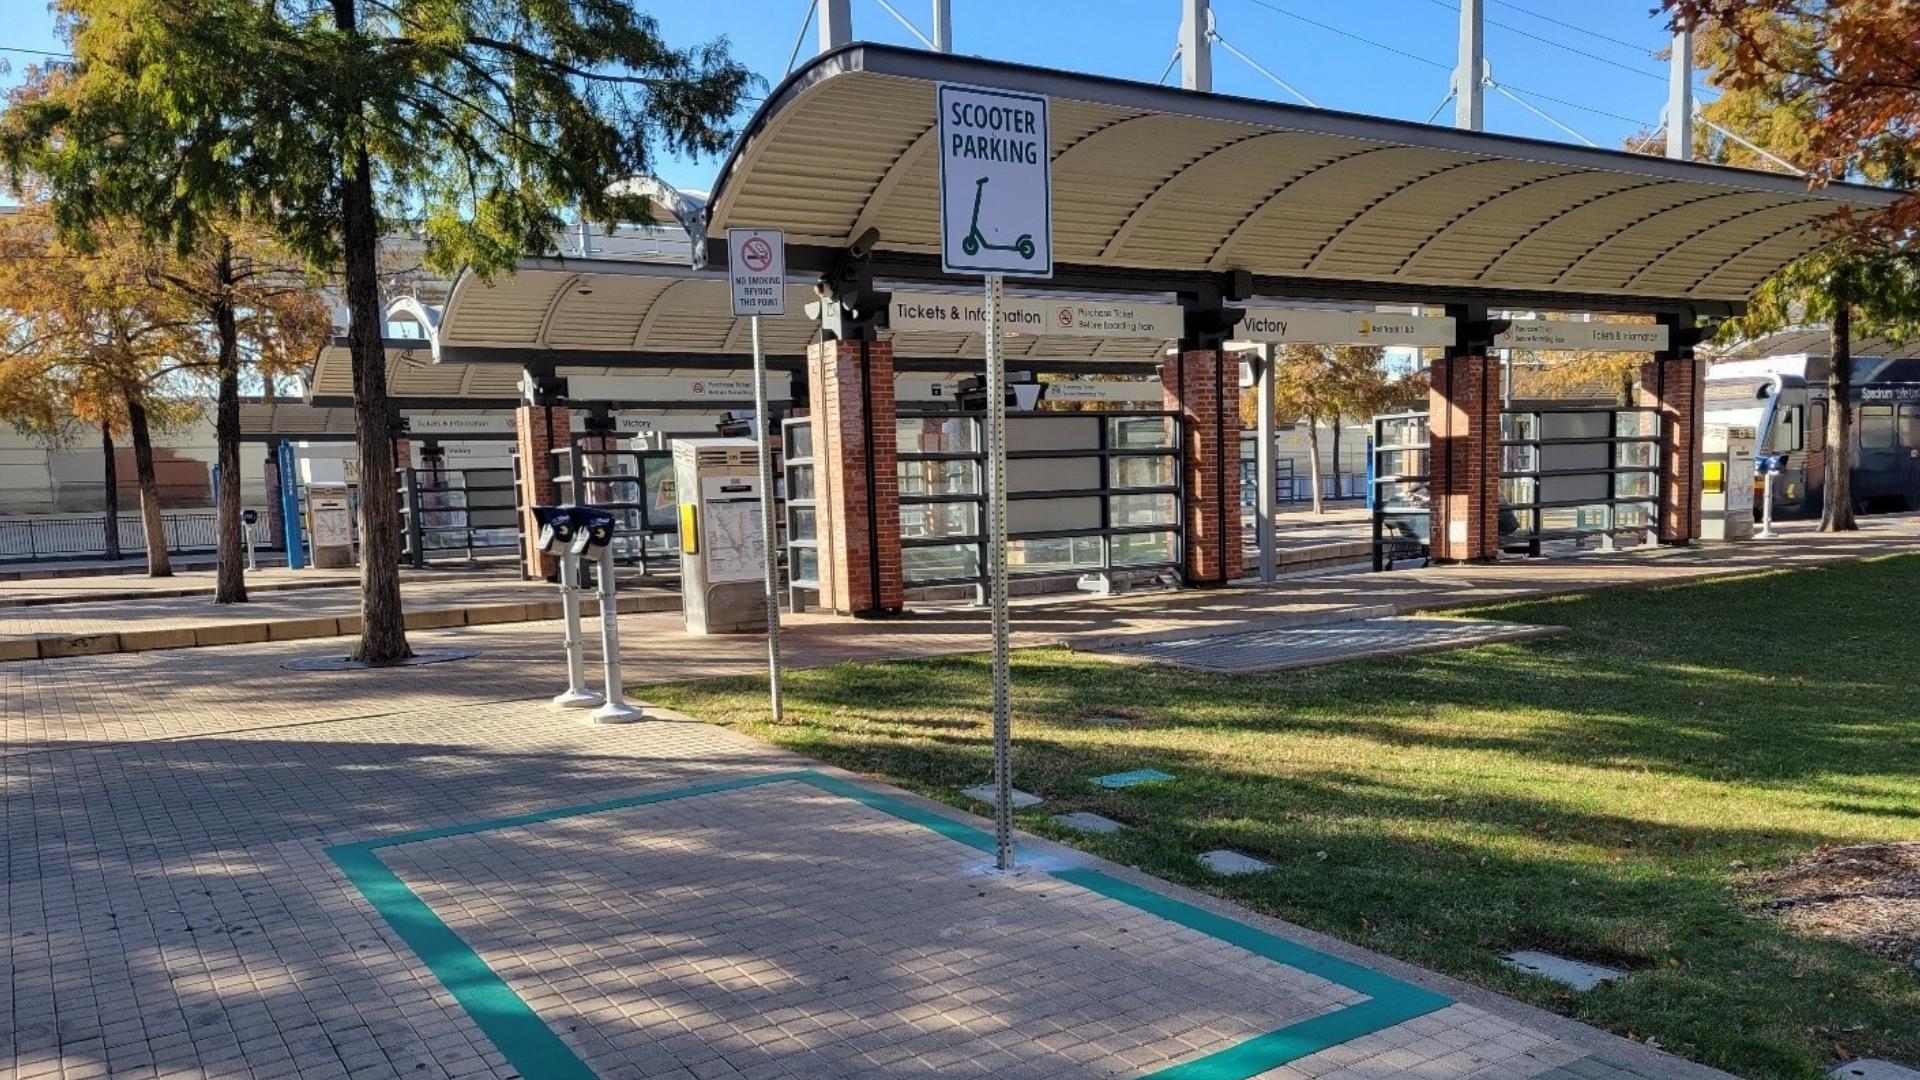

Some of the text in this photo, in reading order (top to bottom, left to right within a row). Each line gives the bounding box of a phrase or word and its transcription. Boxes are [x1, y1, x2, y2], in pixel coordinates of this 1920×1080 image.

[952, 102, 1036, 134] SCOOTER
[952, 133, 1037, 165] PARKING
[736, 276, 781, 285] NO SMOKING
[744, 287, 773, 296] BEYOND
[740, 298, 779, 307] THIS POINT
[897, 303, 1041, 324] Tickets & Infoation
[1245, 317, 1287, 336] Victory
[622, 418, 651, 429] Victory
